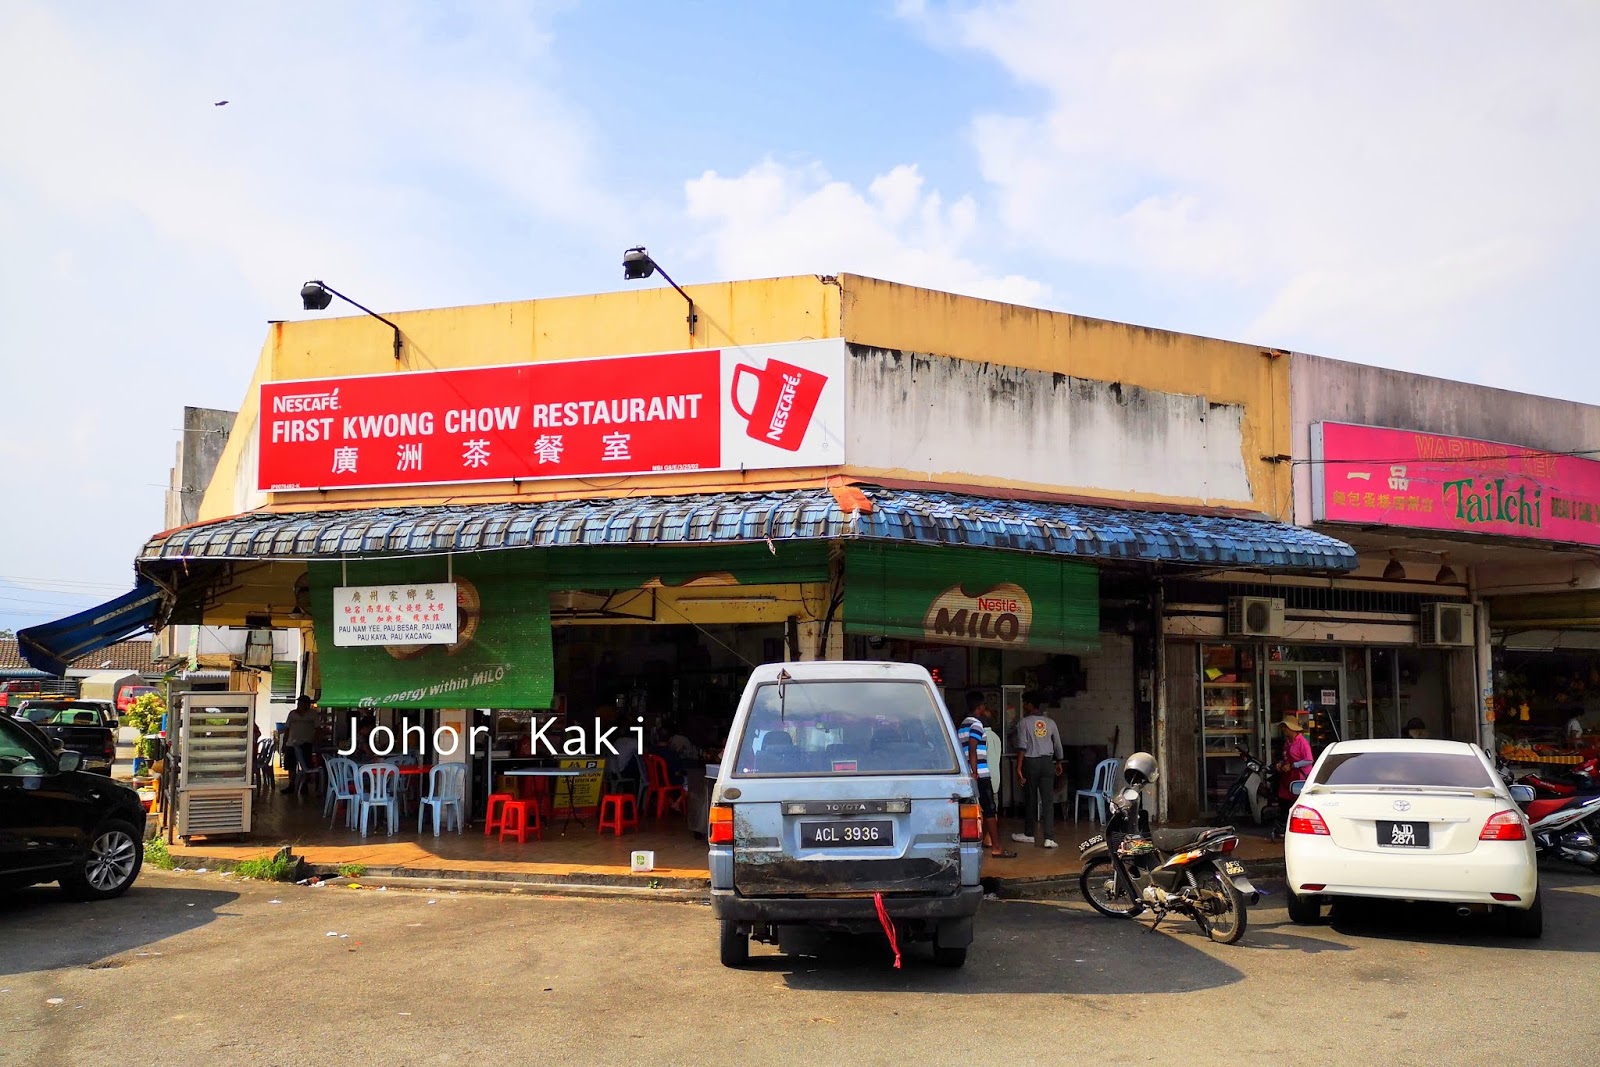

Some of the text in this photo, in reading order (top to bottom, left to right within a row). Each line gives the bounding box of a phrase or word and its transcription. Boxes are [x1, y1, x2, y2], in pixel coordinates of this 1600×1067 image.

[272, 393, 703, 444] FIRST KWONG CHOW RESTAURANT
[331, 431, 632, 475] 廣洲茶餐室
[1415, 435, 1509, 471] WARUNG
[1347, 465, 1410, 491] 一品
[338, 625, 351, 633] PAU
[352, 625, 367, 633] NAM
[383, 624, 396, 632] PAU
[422, 623, 435, 631] PAU
[935, 608, 1020, 641] MILO
[357, 633, 370, 641] PAU
[390, 633, 403, 641] PAU
[405, 632, 432, 640] KACANG
[382, 686, 428, 704] energy
[429, 677, 469, 696] within
[826, 803, 866, 811] TOYOTA
[815, 827, 879, 841] ACL 3936
[1391, 834, 1415, 845] 2871
[1392, 824, 1413, 835] AJD
